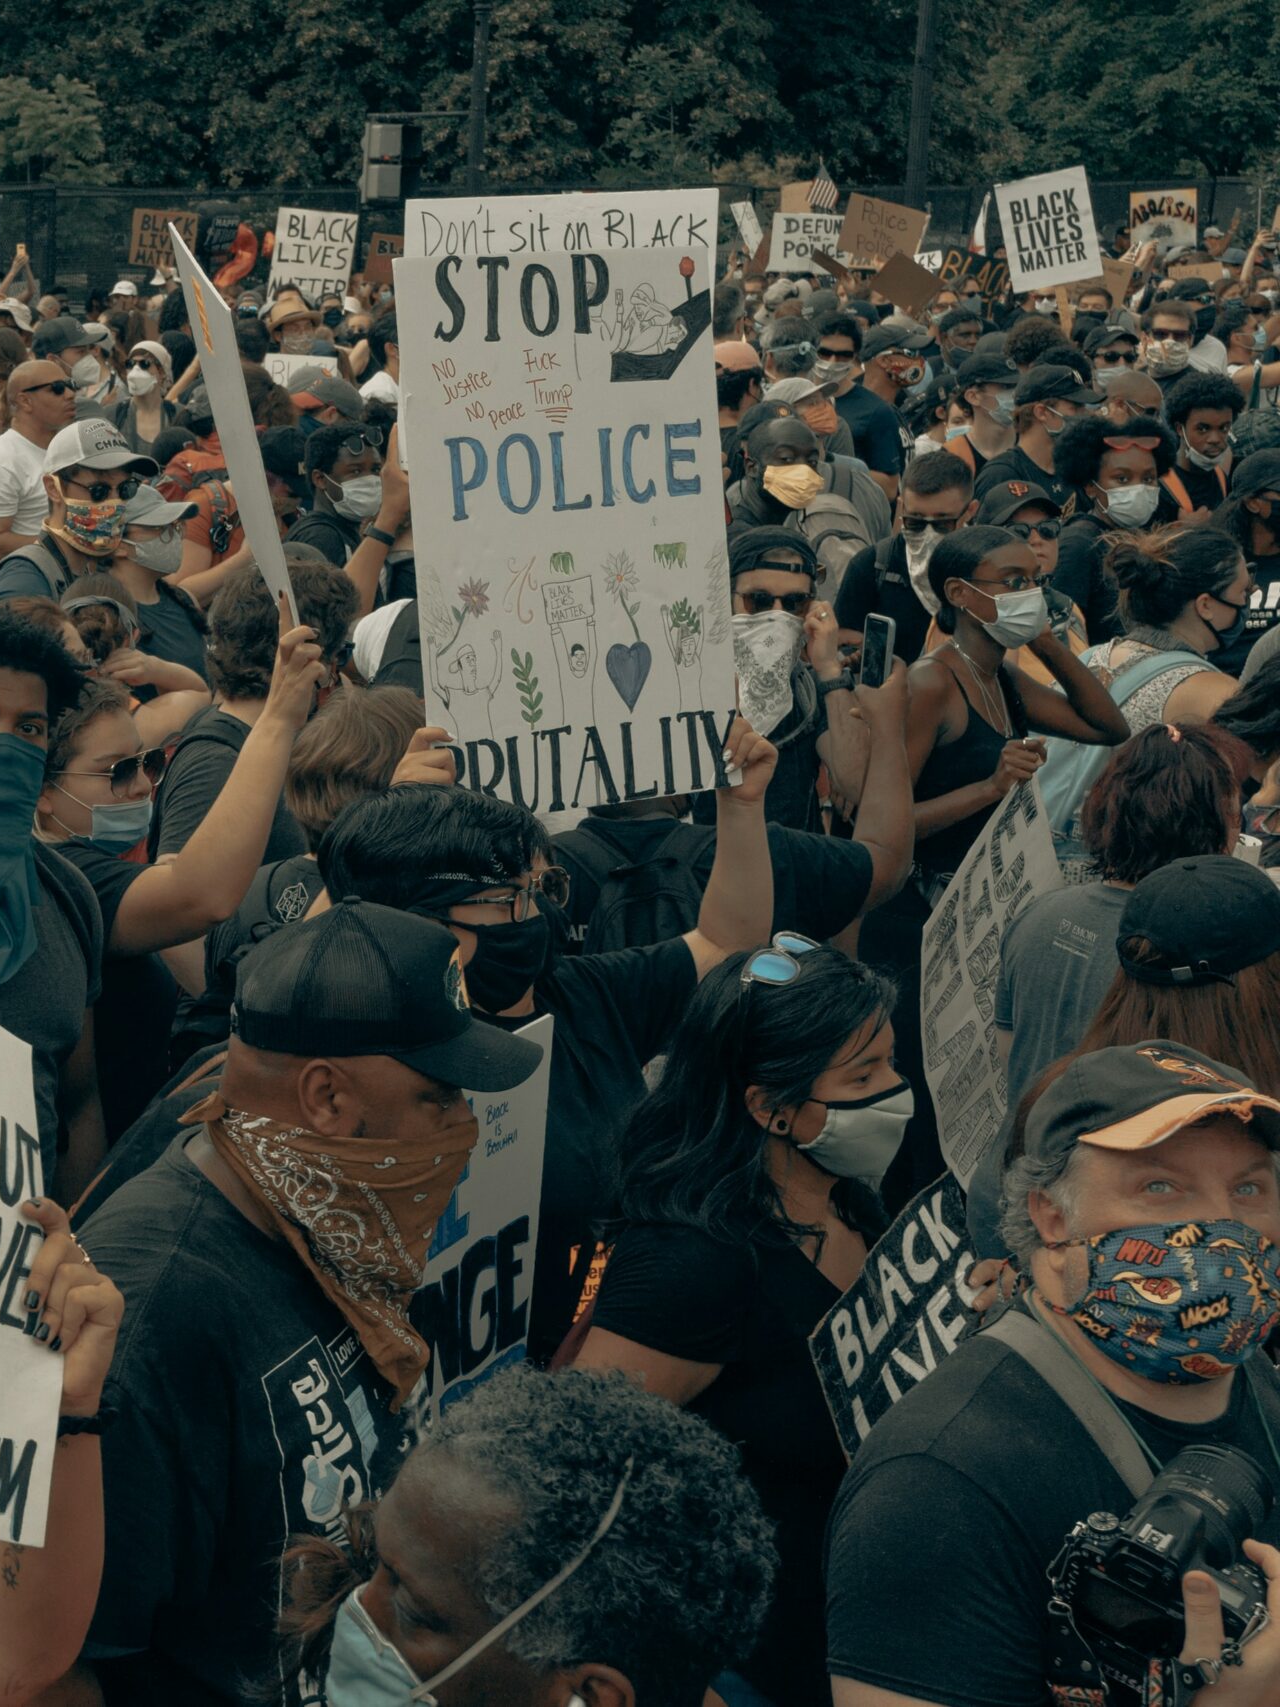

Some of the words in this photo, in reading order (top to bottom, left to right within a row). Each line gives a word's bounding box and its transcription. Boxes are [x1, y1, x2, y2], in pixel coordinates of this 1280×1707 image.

[862, 200, 909, 232] Police
[1009, 187, 1078, 225] BLACK
[287, 214, 357, 244] BLACK
[421, 204, 495, 257] Don't
[509, 209, 550, 253] sit
[564, 222, 593, 251] on
[602, 208, 710, 249] BLACK
[784, 218, 842, 235] DEFUN
[872, 226, 895, 244] the
[1014, 213, 1083, 253] LIVES
[277, 243, 347, 270] LIVES
[1018, 241, 1087, 273] MATTER
[268, 276, 346, 297] MTTER
[434, 253, 610, 343] STOP
[431, 357, 456, 382] NO
[465, 401, 485, 422] NO
[444, 418, 701, 521] POLICE
[551, 603, 586, 621] MATTER
[831, 1190, 960, 1388] BLACK
[408, 1215, 529, 1397] NGE
[335, 1335, 357, 1365] LOVE
